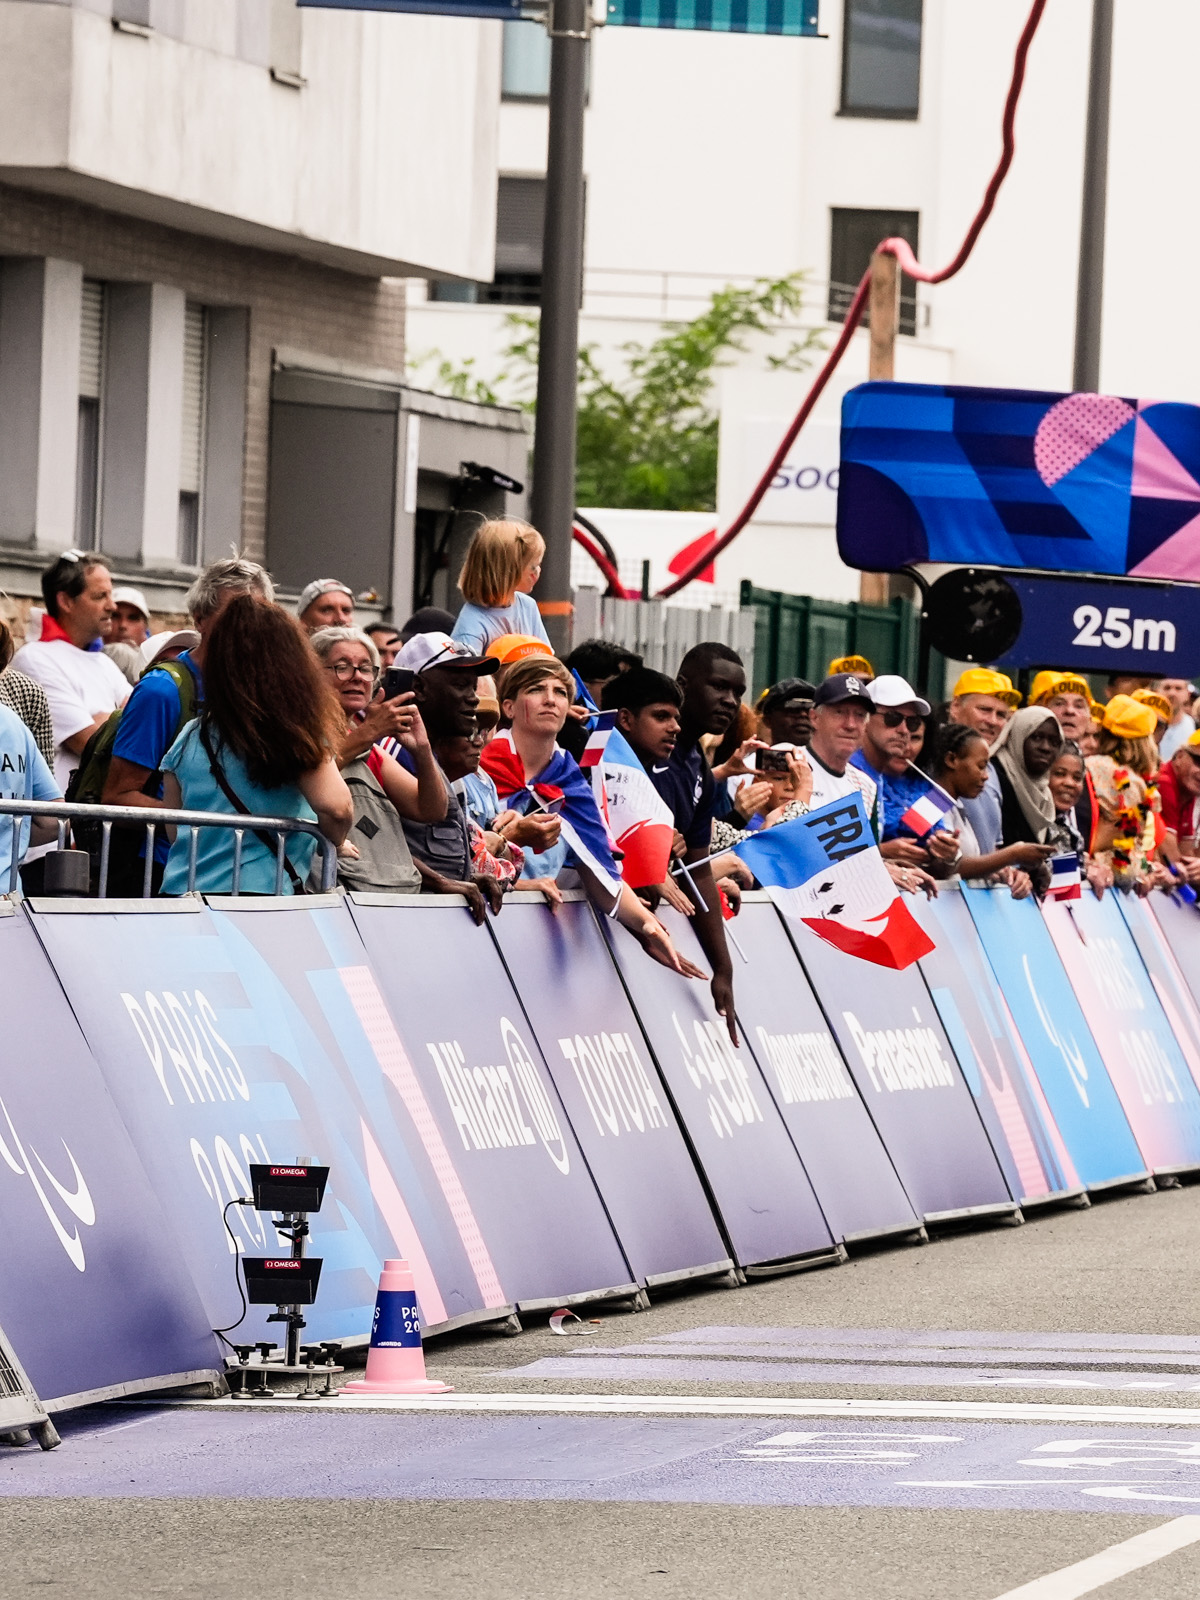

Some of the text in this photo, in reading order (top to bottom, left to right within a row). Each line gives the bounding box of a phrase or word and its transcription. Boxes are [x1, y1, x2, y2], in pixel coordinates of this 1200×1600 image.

[1071, 604, 1176, 652] 25m
[557, 1031, 669, 1137] TOYOTA
[842, 1006, 955, 1093] Panasonic
[426, 1039, 537, 1151] Allianz
[280, 1168, 305, 1176] OMEGA
